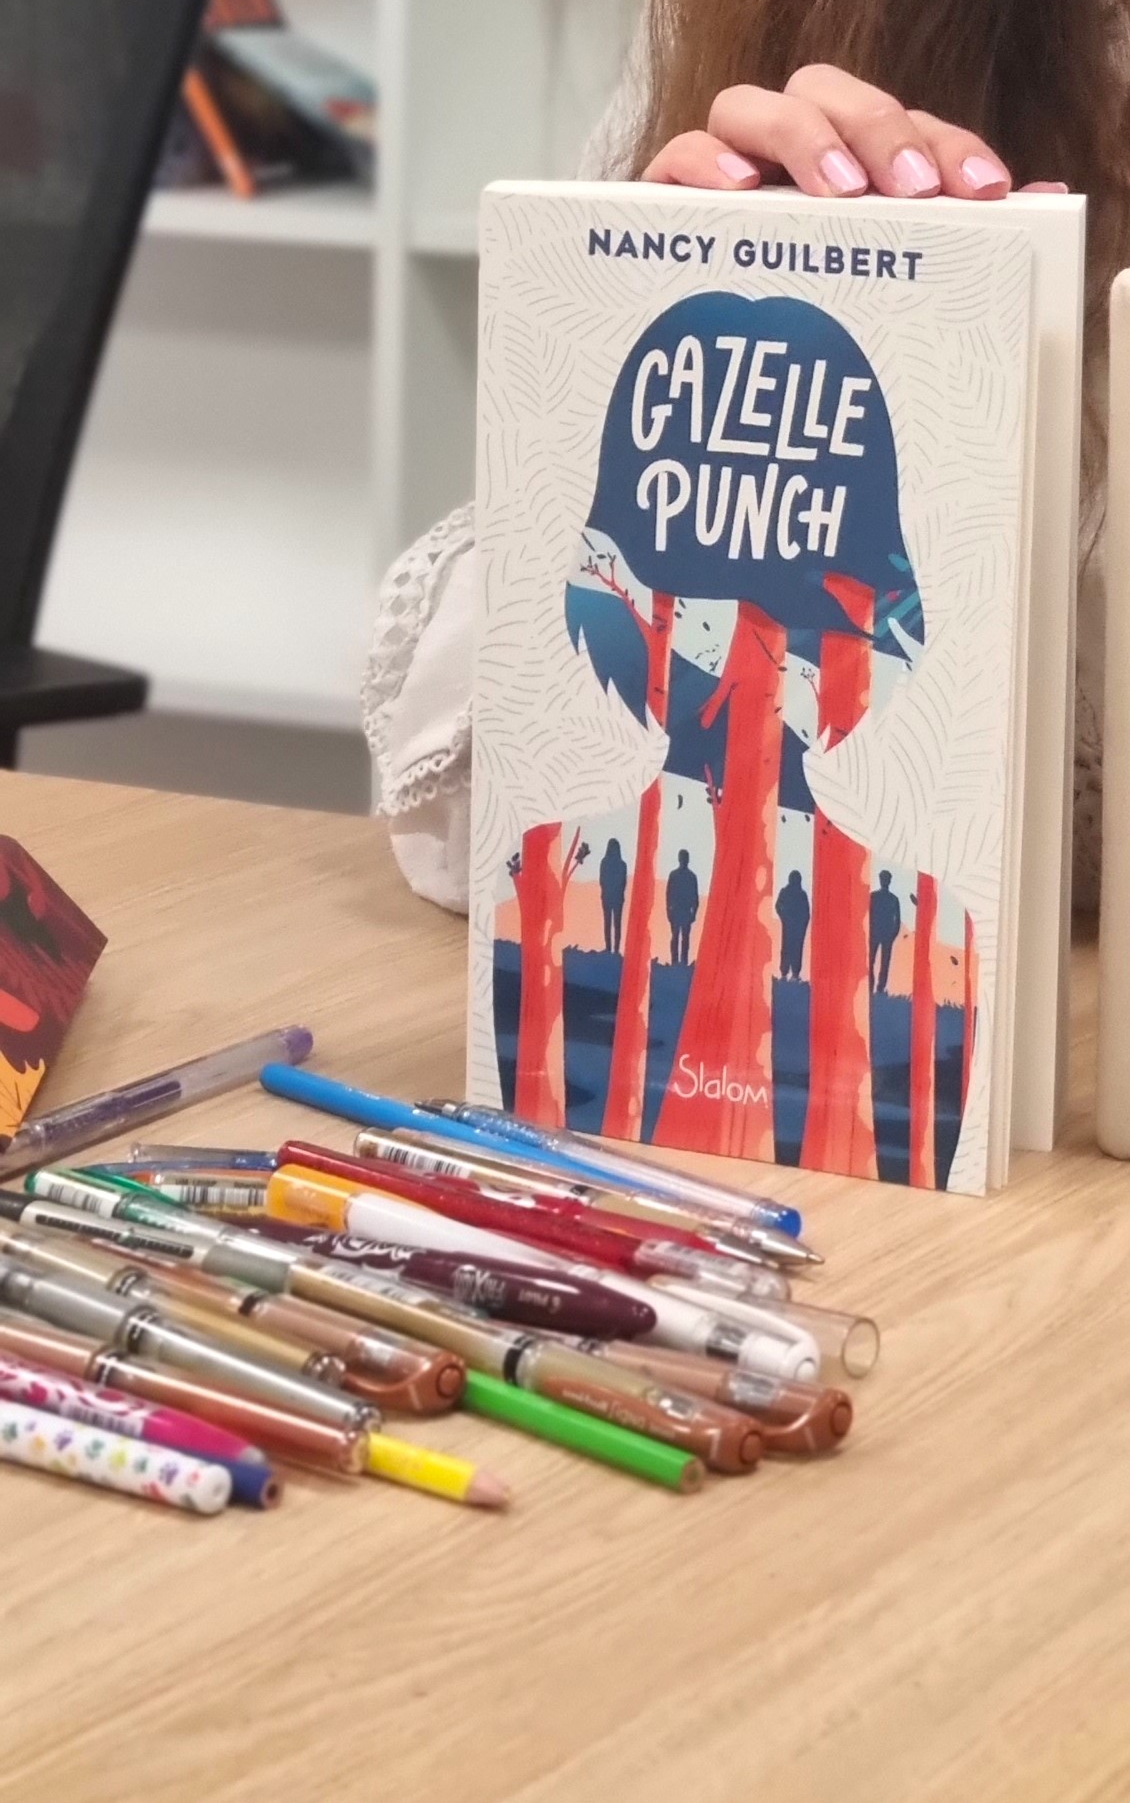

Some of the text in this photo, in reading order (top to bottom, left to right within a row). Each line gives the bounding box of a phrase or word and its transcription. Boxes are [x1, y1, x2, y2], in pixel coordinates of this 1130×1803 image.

[588, 228, 923, 280] NANCY GUILBERT
[631, 334, 872, 461] GAZELLE
[636, 458, 846, 561] PUNCH
[673, 1053, 768, 1109] Slalom
